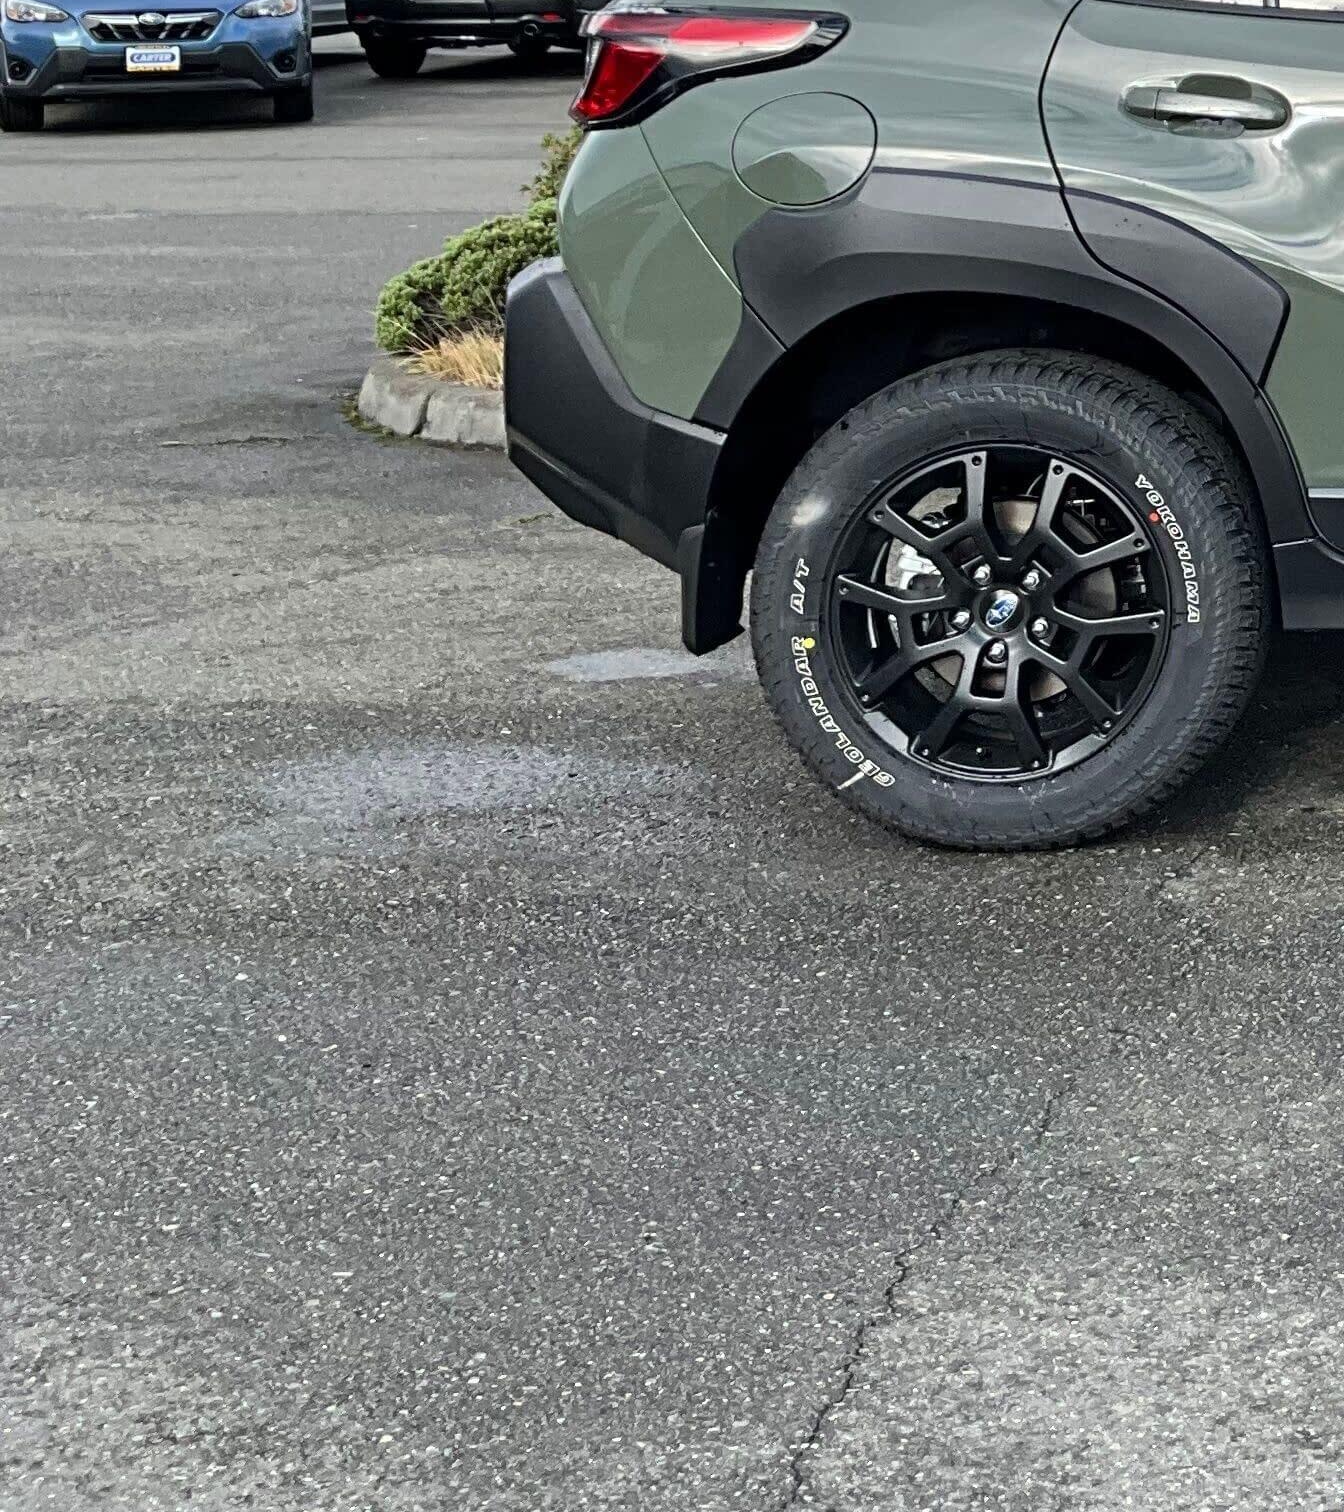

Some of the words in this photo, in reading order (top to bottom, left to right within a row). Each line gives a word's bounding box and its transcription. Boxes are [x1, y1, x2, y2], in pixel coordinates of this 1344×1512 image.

[133, 52, 172, 62] CARTER
[790, 558, 810, 614] A/T
[1135, 474, 1201, 623] YOKOHAMA
[791, 635, 896, 787] GEOLANDAR
